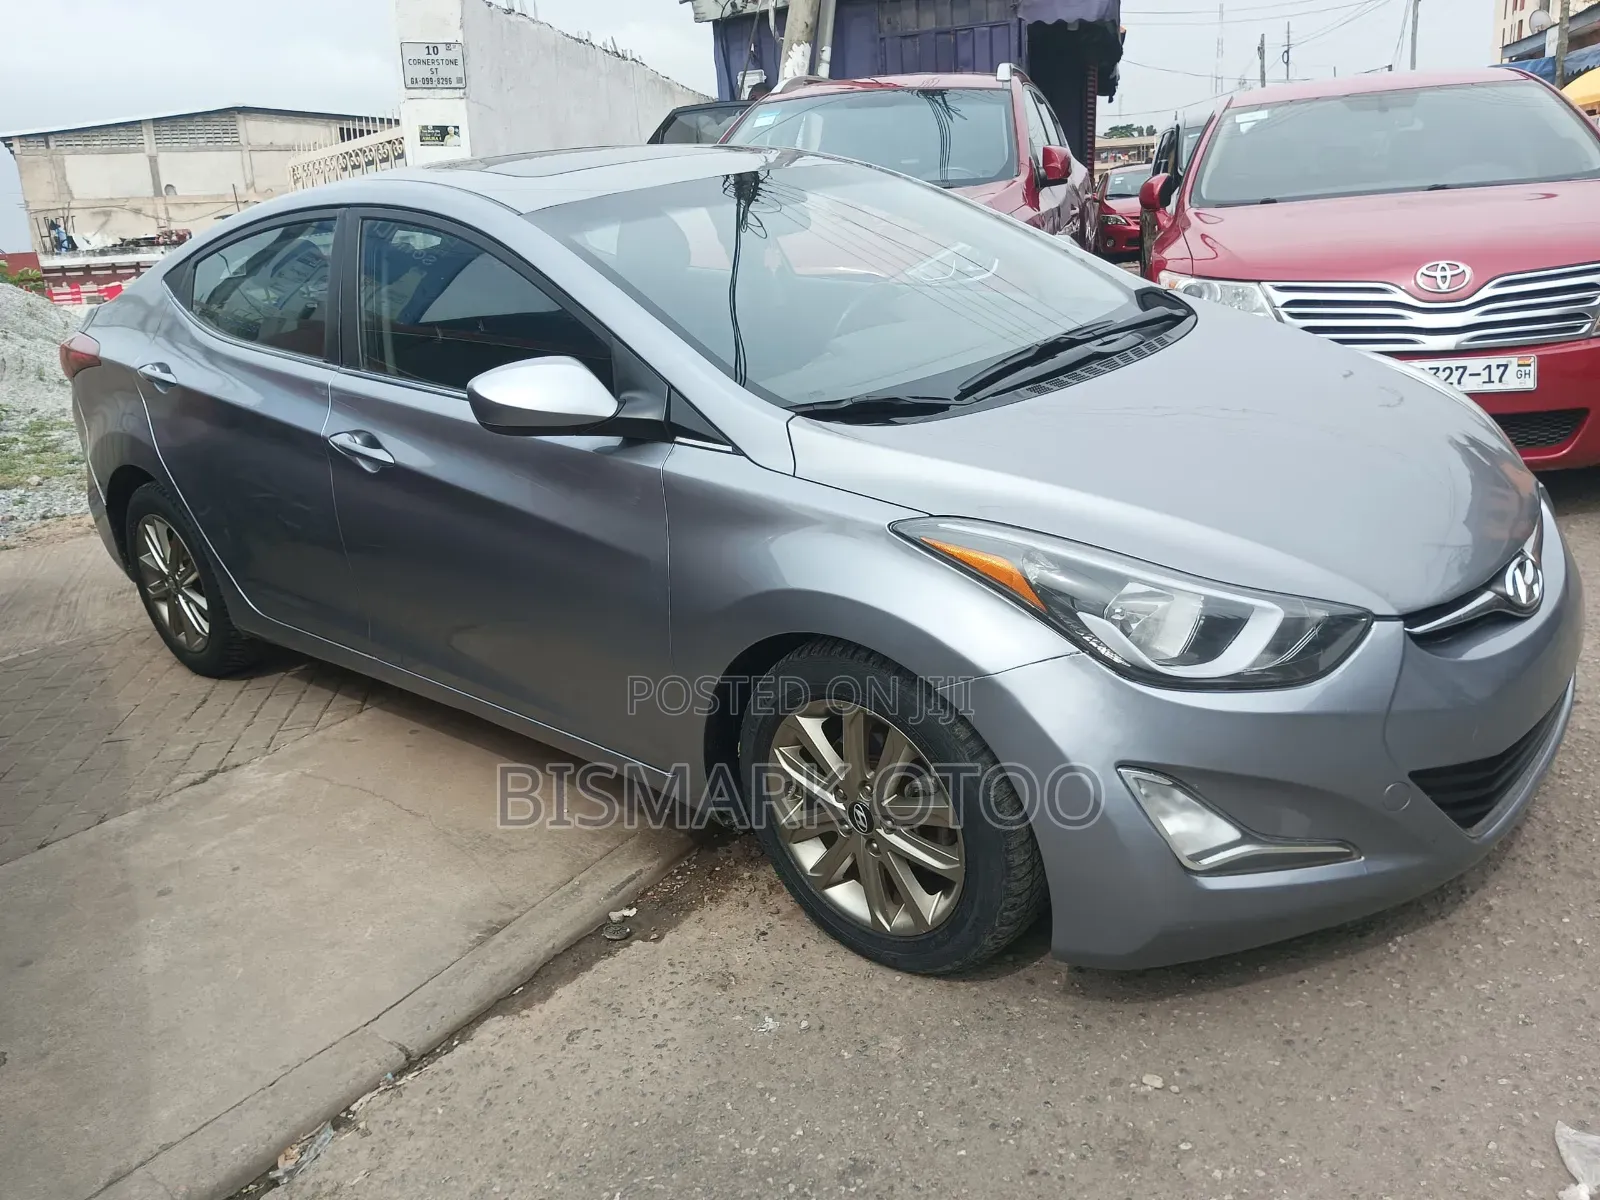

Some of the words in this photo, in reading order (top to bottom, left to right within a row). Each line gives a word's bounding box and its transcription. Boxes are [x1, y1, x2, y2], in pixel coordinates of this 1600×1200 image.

[425, 45, 439, 56] 10
[408, 58, 459, 66] CORNERSTONE
[429, 67, 439, 75] ST
[1420, 363, 1509, 385] 327-17
[1516, 369, 1531, 379] GH
